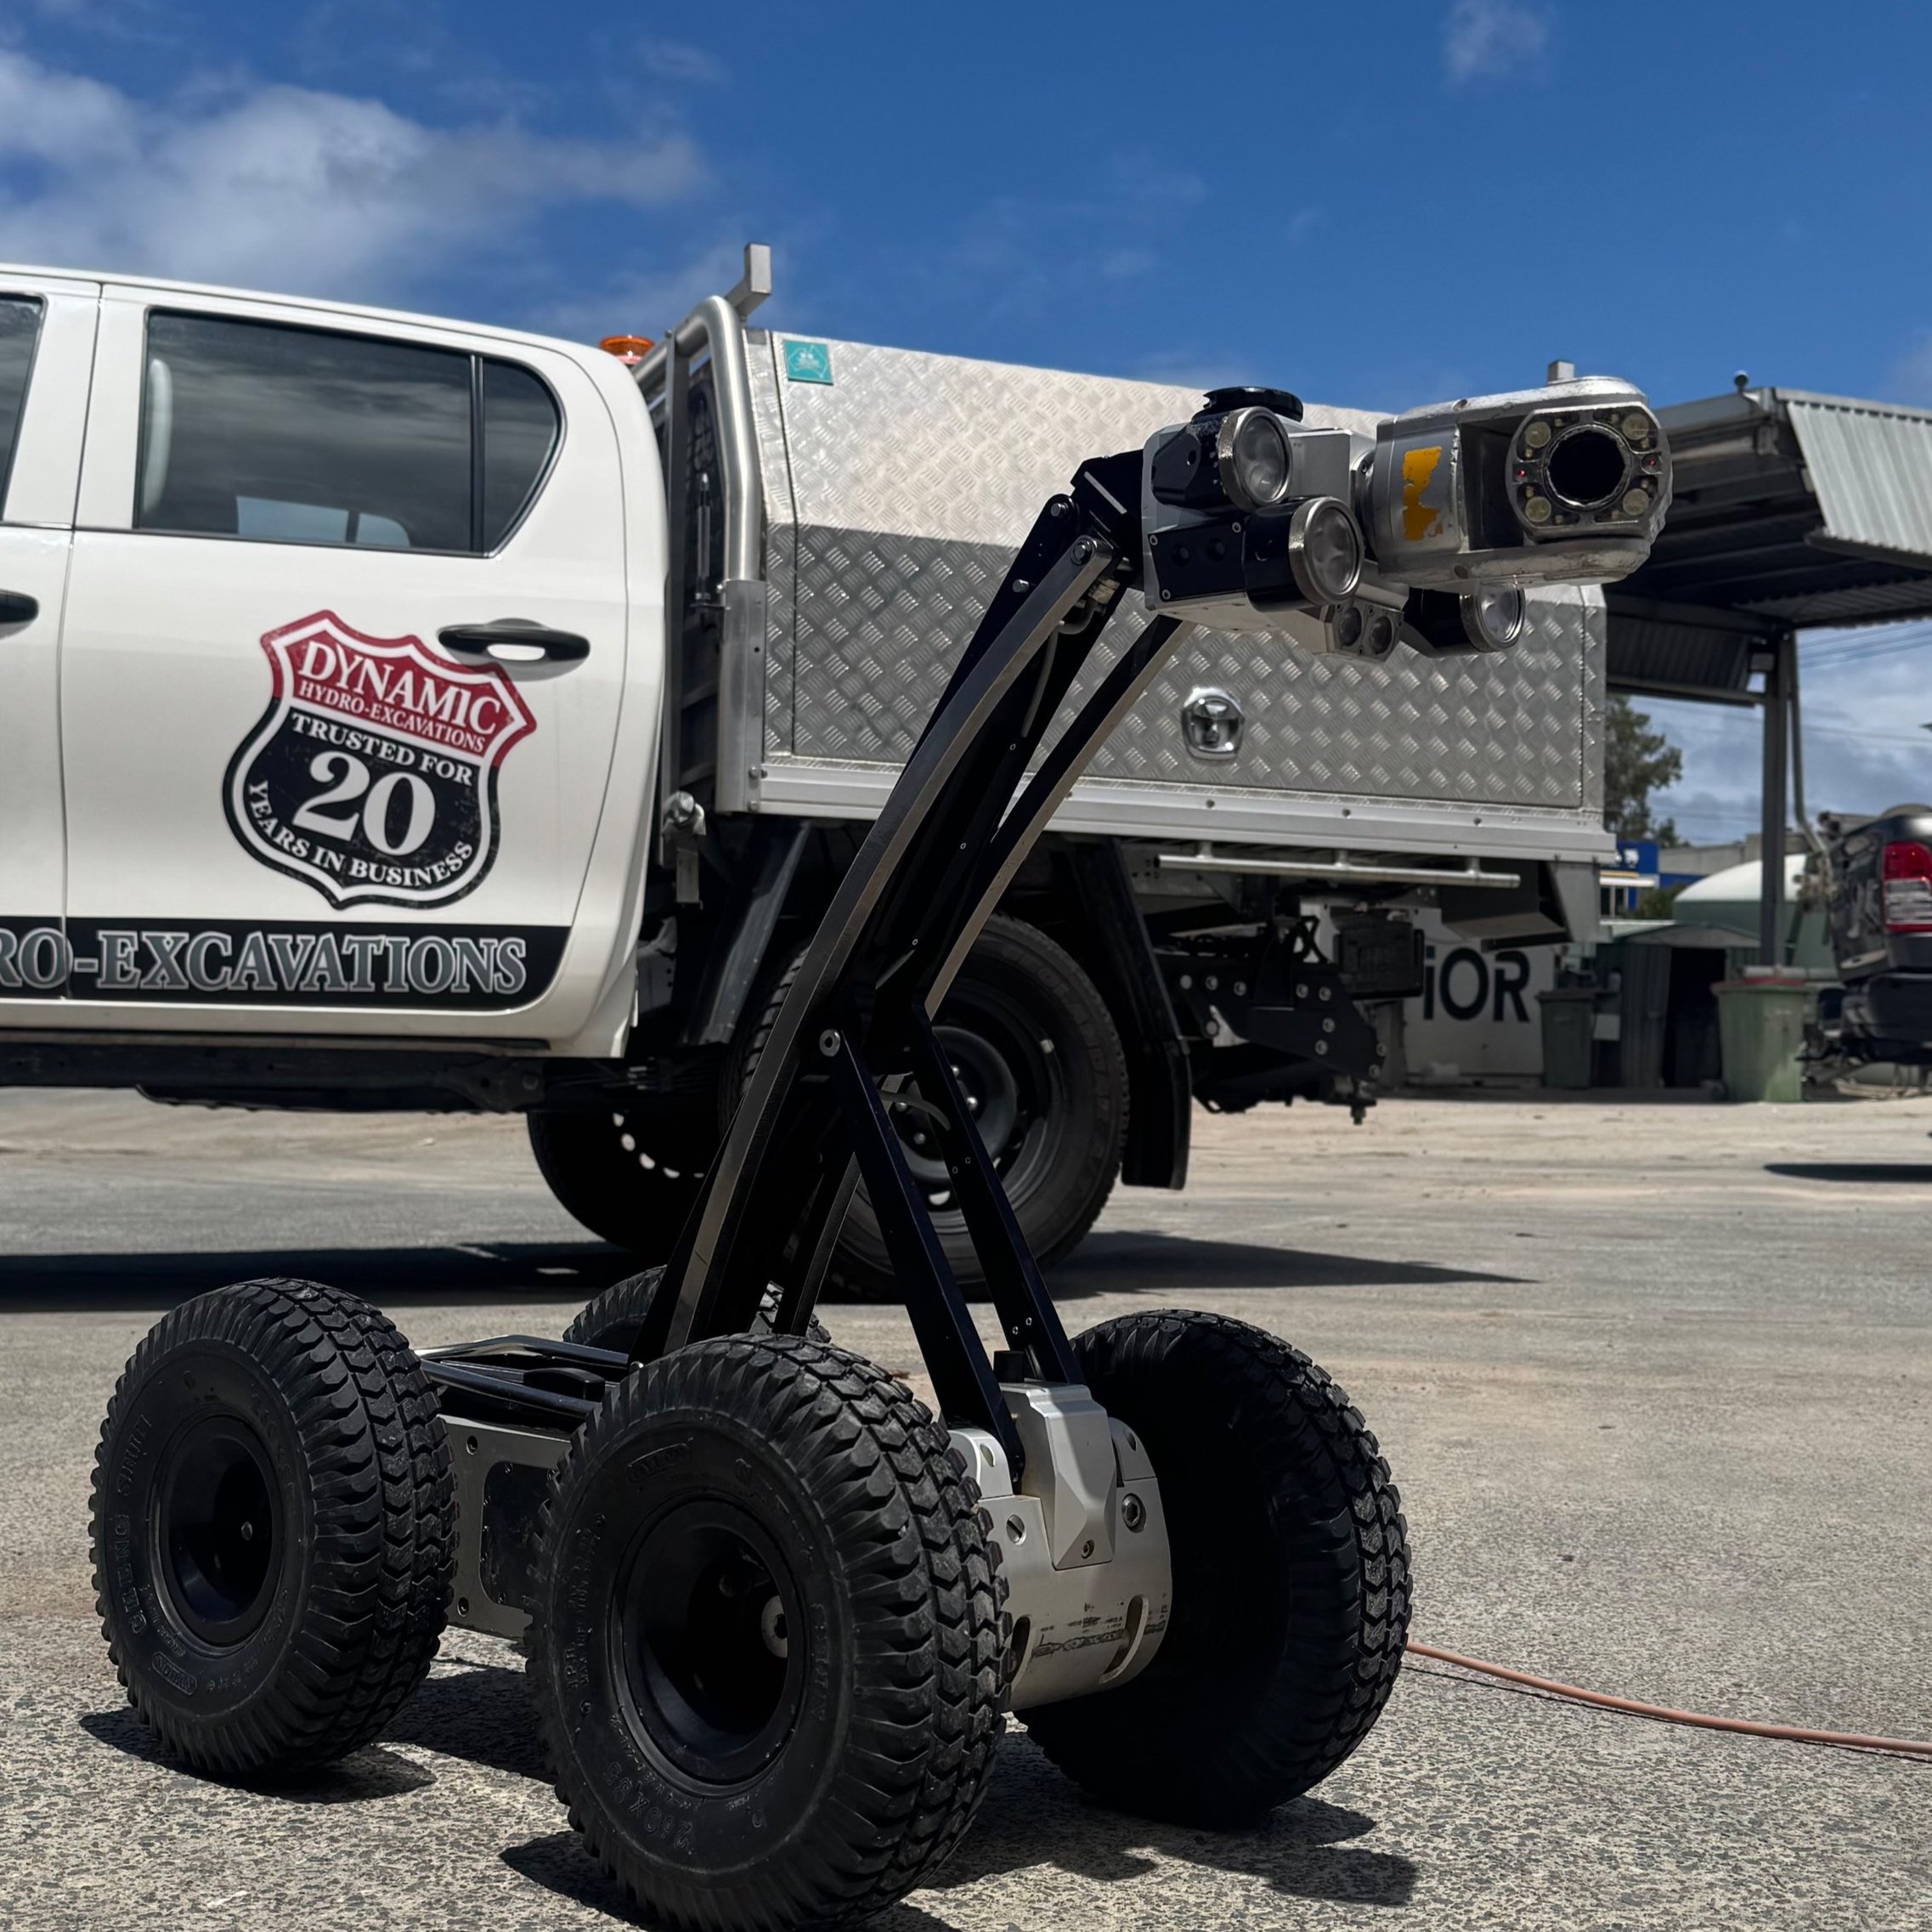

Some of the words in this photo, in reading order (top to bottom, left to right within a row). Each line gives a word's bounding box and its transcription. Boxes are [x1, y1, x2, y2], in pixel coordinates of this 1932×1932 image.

[298, 641, 500, 734] DYNAMIC
[299, 681, 486, 752] HYDRO-EXCAVATIONS
[291, 713, 415, 766] TRUSTED
[421, 754, 473, 786] FOR
[249, 780, 310, 858] YEARS
[313, 845, 347, 873] IN
[348, 841, 472, 886] BUSINESS
[291, 750, 436, 856] 20
